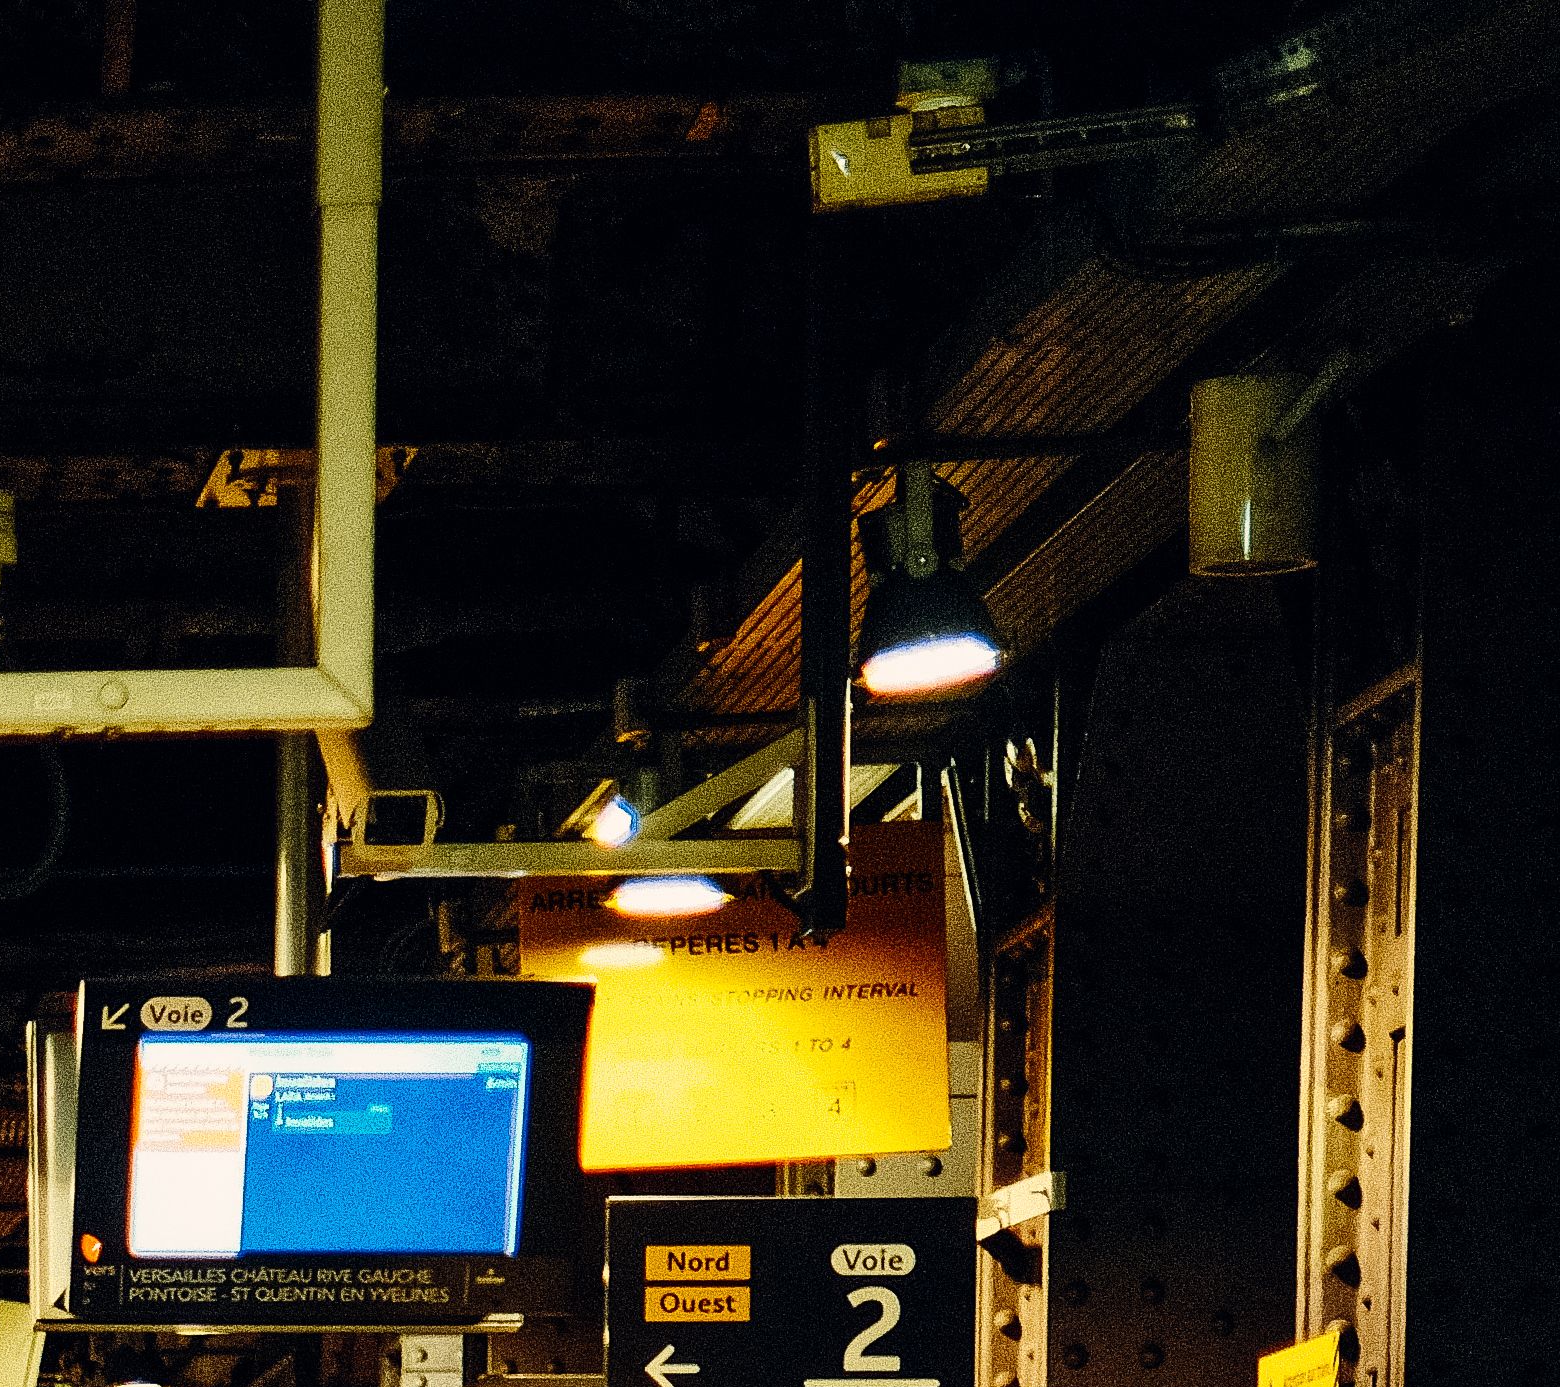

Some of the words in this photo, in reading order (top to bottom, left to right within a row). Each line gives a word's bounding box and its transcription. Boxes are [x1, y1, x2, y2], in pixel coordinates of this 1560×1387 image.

[822, 981, 920, 1001] INTERVAL
[149, 1003, 204, 1024] Voie
[226, 996, 249, 1029] 2
[666, 1251, 730, 1274] Nord
[841, 1248, 903, 1272] Voie
[129, 1267, 227, 1284] VERSAILLES
[231, 1264, 313, 1284] CHÂTEAU
[317, 1267, 354, 1284] RIVE
[357, 1267, 433, 1284] GAUCHE
[129, 1286, 218, 1303] PONTOISE
[255, 1286, 336, 1304] QUENTIN
[340, 1286, 365, 1303] EN
[368, 1286, 451, 1304] YVELINES
[659, 1292, 737, 1315] Ouest
[842, 1285, 902, 1372] 2
